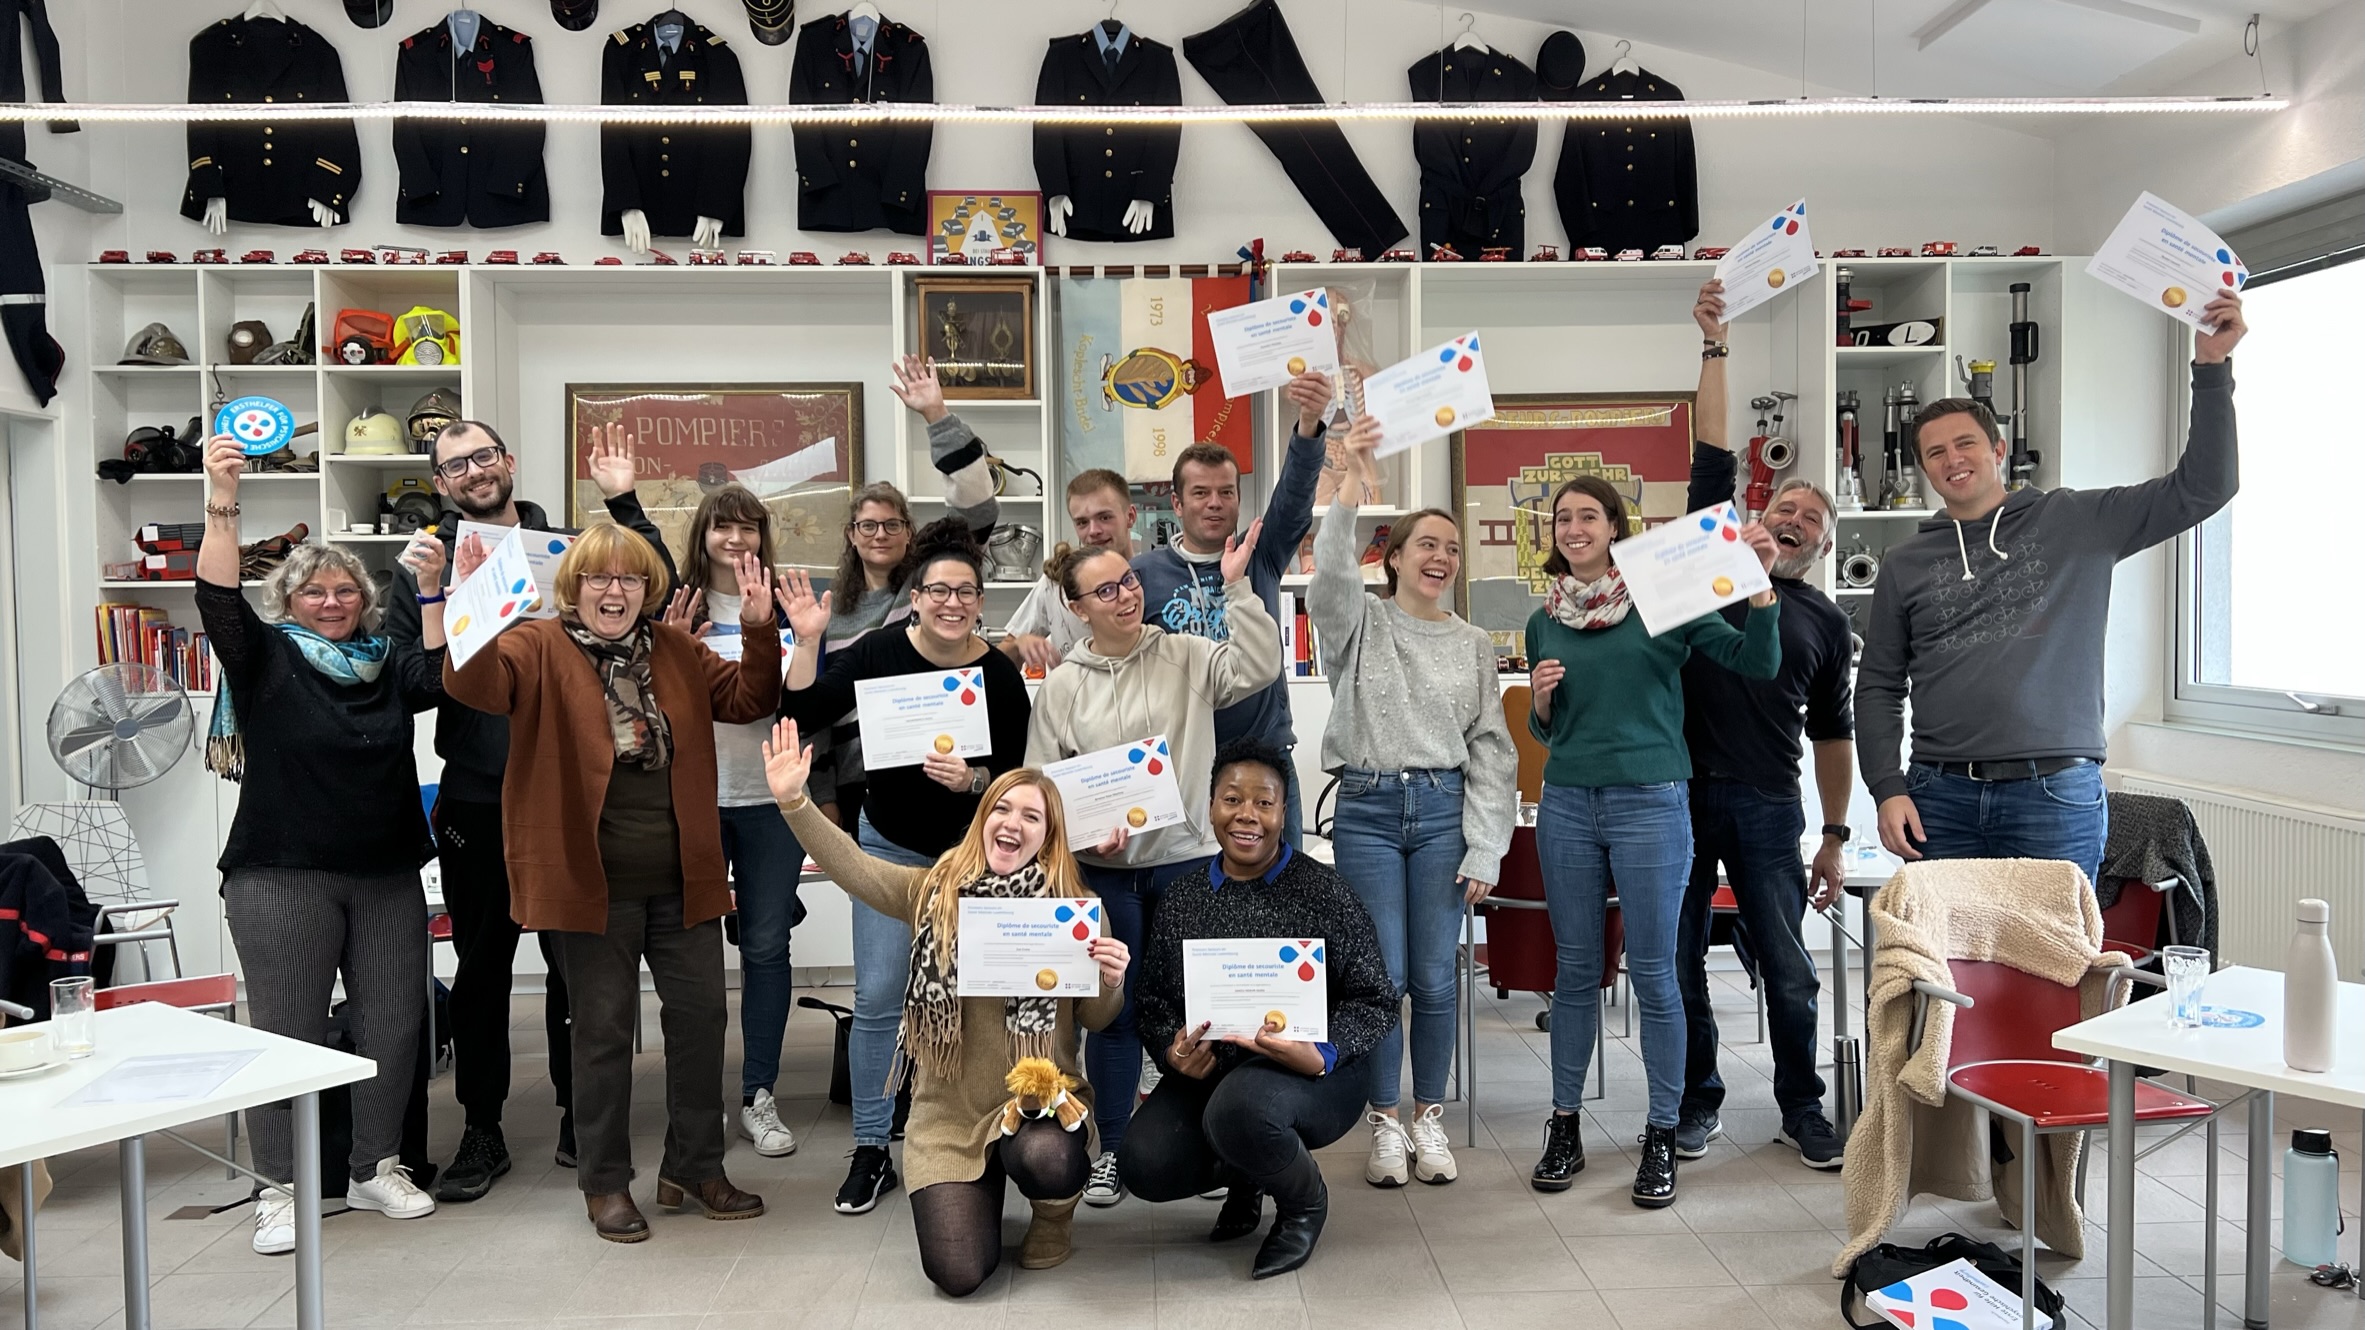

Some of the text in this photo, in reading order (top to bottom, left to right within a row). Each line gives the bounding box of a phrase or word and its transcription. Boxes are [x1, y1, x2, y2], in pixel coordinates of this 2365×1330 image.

[2160, 228, 2183, 243] Diplôme
[2191, 244, 2216, 263] secouriste
[2169, 241, 2184, 253] santé
[2184, 250, 2206, 265] mentale
[1150, 297, 1163, 326] 1973
[1904, 325, 1918, 343] L
[1072, 333, 1097, 434] Koplescht-Bridel
[229, 401, 279, 414] ERSTHELFER
[276, 412, 288, 426] FÜR
[1487, 407, 1667, 429] PEURS-POMPIERS
[250, 425, 289, 451] PSYCHISCHE
[1153, 428, 1167, 457] 1998
[1550, 456, 1599, 469] GOTT
[1524, 470, 1563, 483] ZUR
[892, 696, 914, 705] Diplôme
[1081, 773, 1102, 784] Diplôme
[1111, 765, 1136, 776] secouriste
[1095, 780, 1109, 788] santé
[1110, 774, 1131, 784] mentale
[997, 922, 1021, 930] Diplôme
[1222, 963, 1246, 971] Diplôme
[1953, 1270, 1989, 1296] Gesundheit
[1984, 1297, 2000, 1310] Hilfe
[2000, 1309, 2018, 1322] Erste
